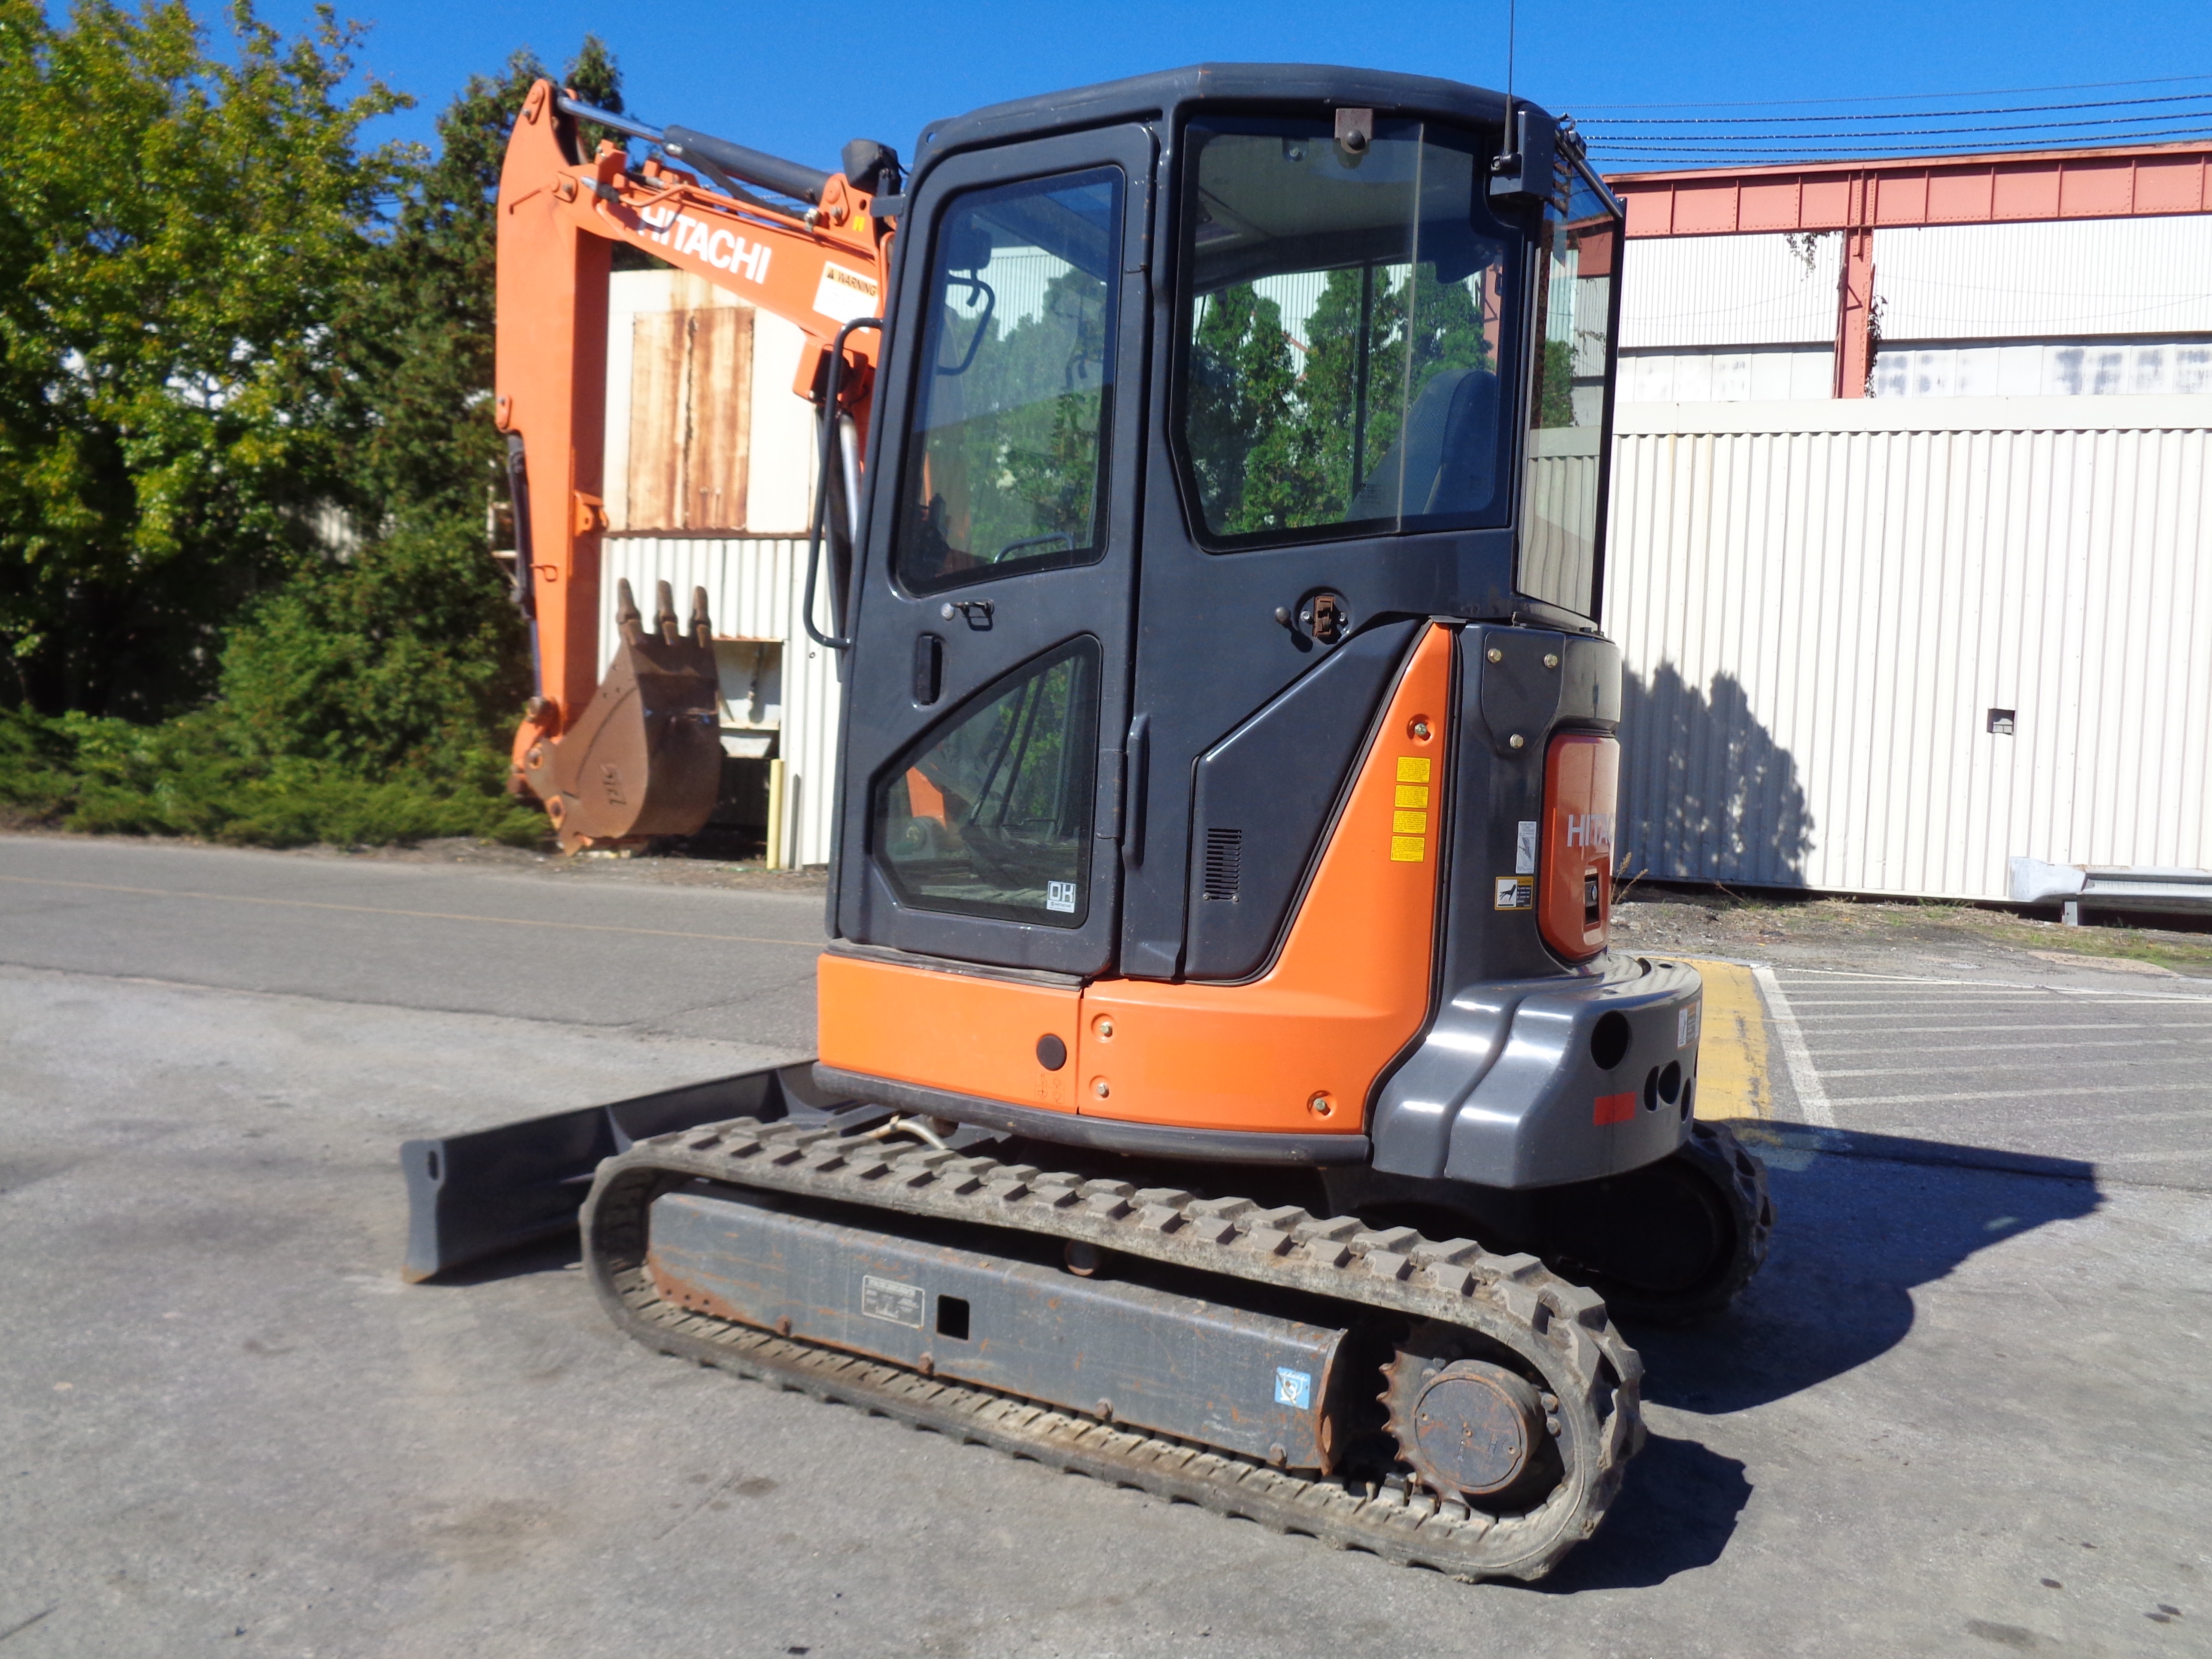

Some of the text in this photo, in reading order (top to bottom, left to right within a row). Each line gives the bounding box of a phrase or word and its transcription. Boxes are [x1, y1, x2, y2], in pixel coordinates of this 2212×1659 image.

[637, 206, 772, 285] HITACHI
[838, 270, 877, 296] WARNING
[1050, 883, 1073, 902] OK
